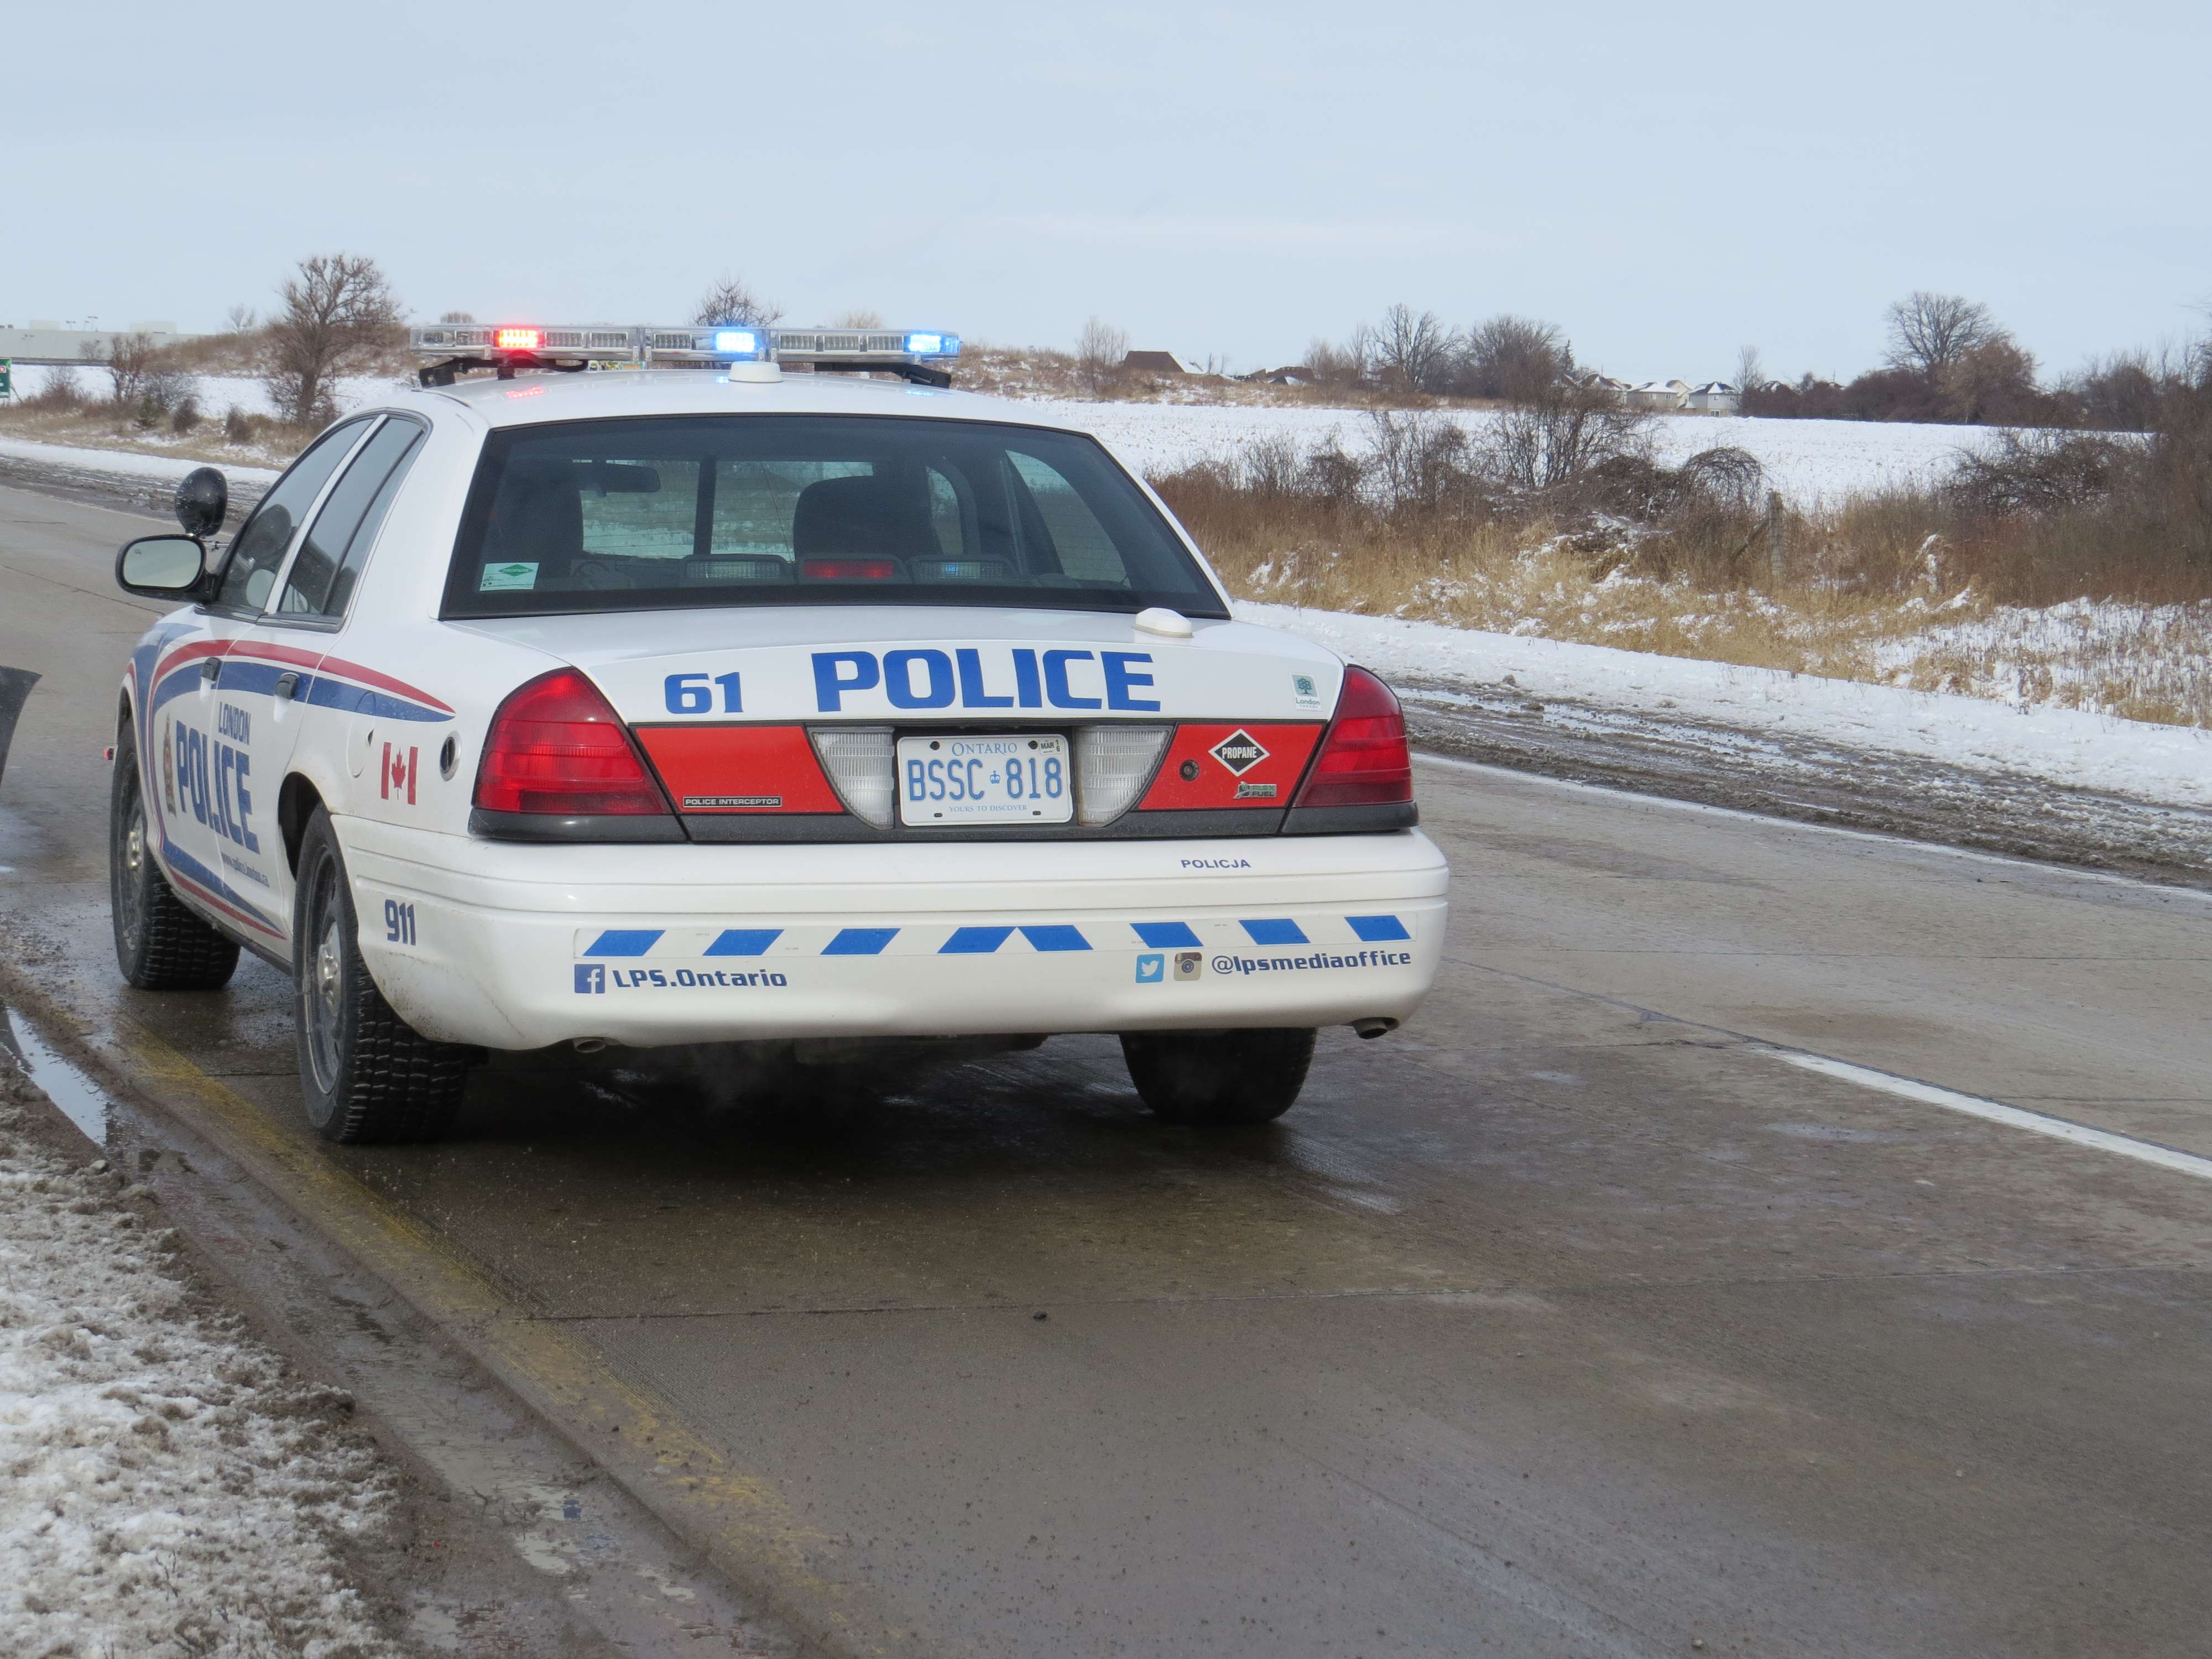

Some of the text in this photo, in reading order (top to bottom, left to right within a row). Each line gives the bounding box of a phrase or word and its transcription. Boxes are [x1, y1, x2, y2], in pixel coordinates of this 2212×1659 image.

[665, 648, 1161, 713] 61 POLICE
[1295, 697, 1321, 706] London
[218, 701, 251, 746] LONDON
[1222, 746, 1257, 759] PROPANE
[176, 719, 261, 855] POLICE
[907, 757, 1062, 801] BSSC 818
[1180, 859, 1251, 869] POLICJA
[385, 898, 416, 946] 911
[612, 969, 787, 988] LPS.Ontario
[1211, 950, 1412, 975] @lpsmediaoffice
